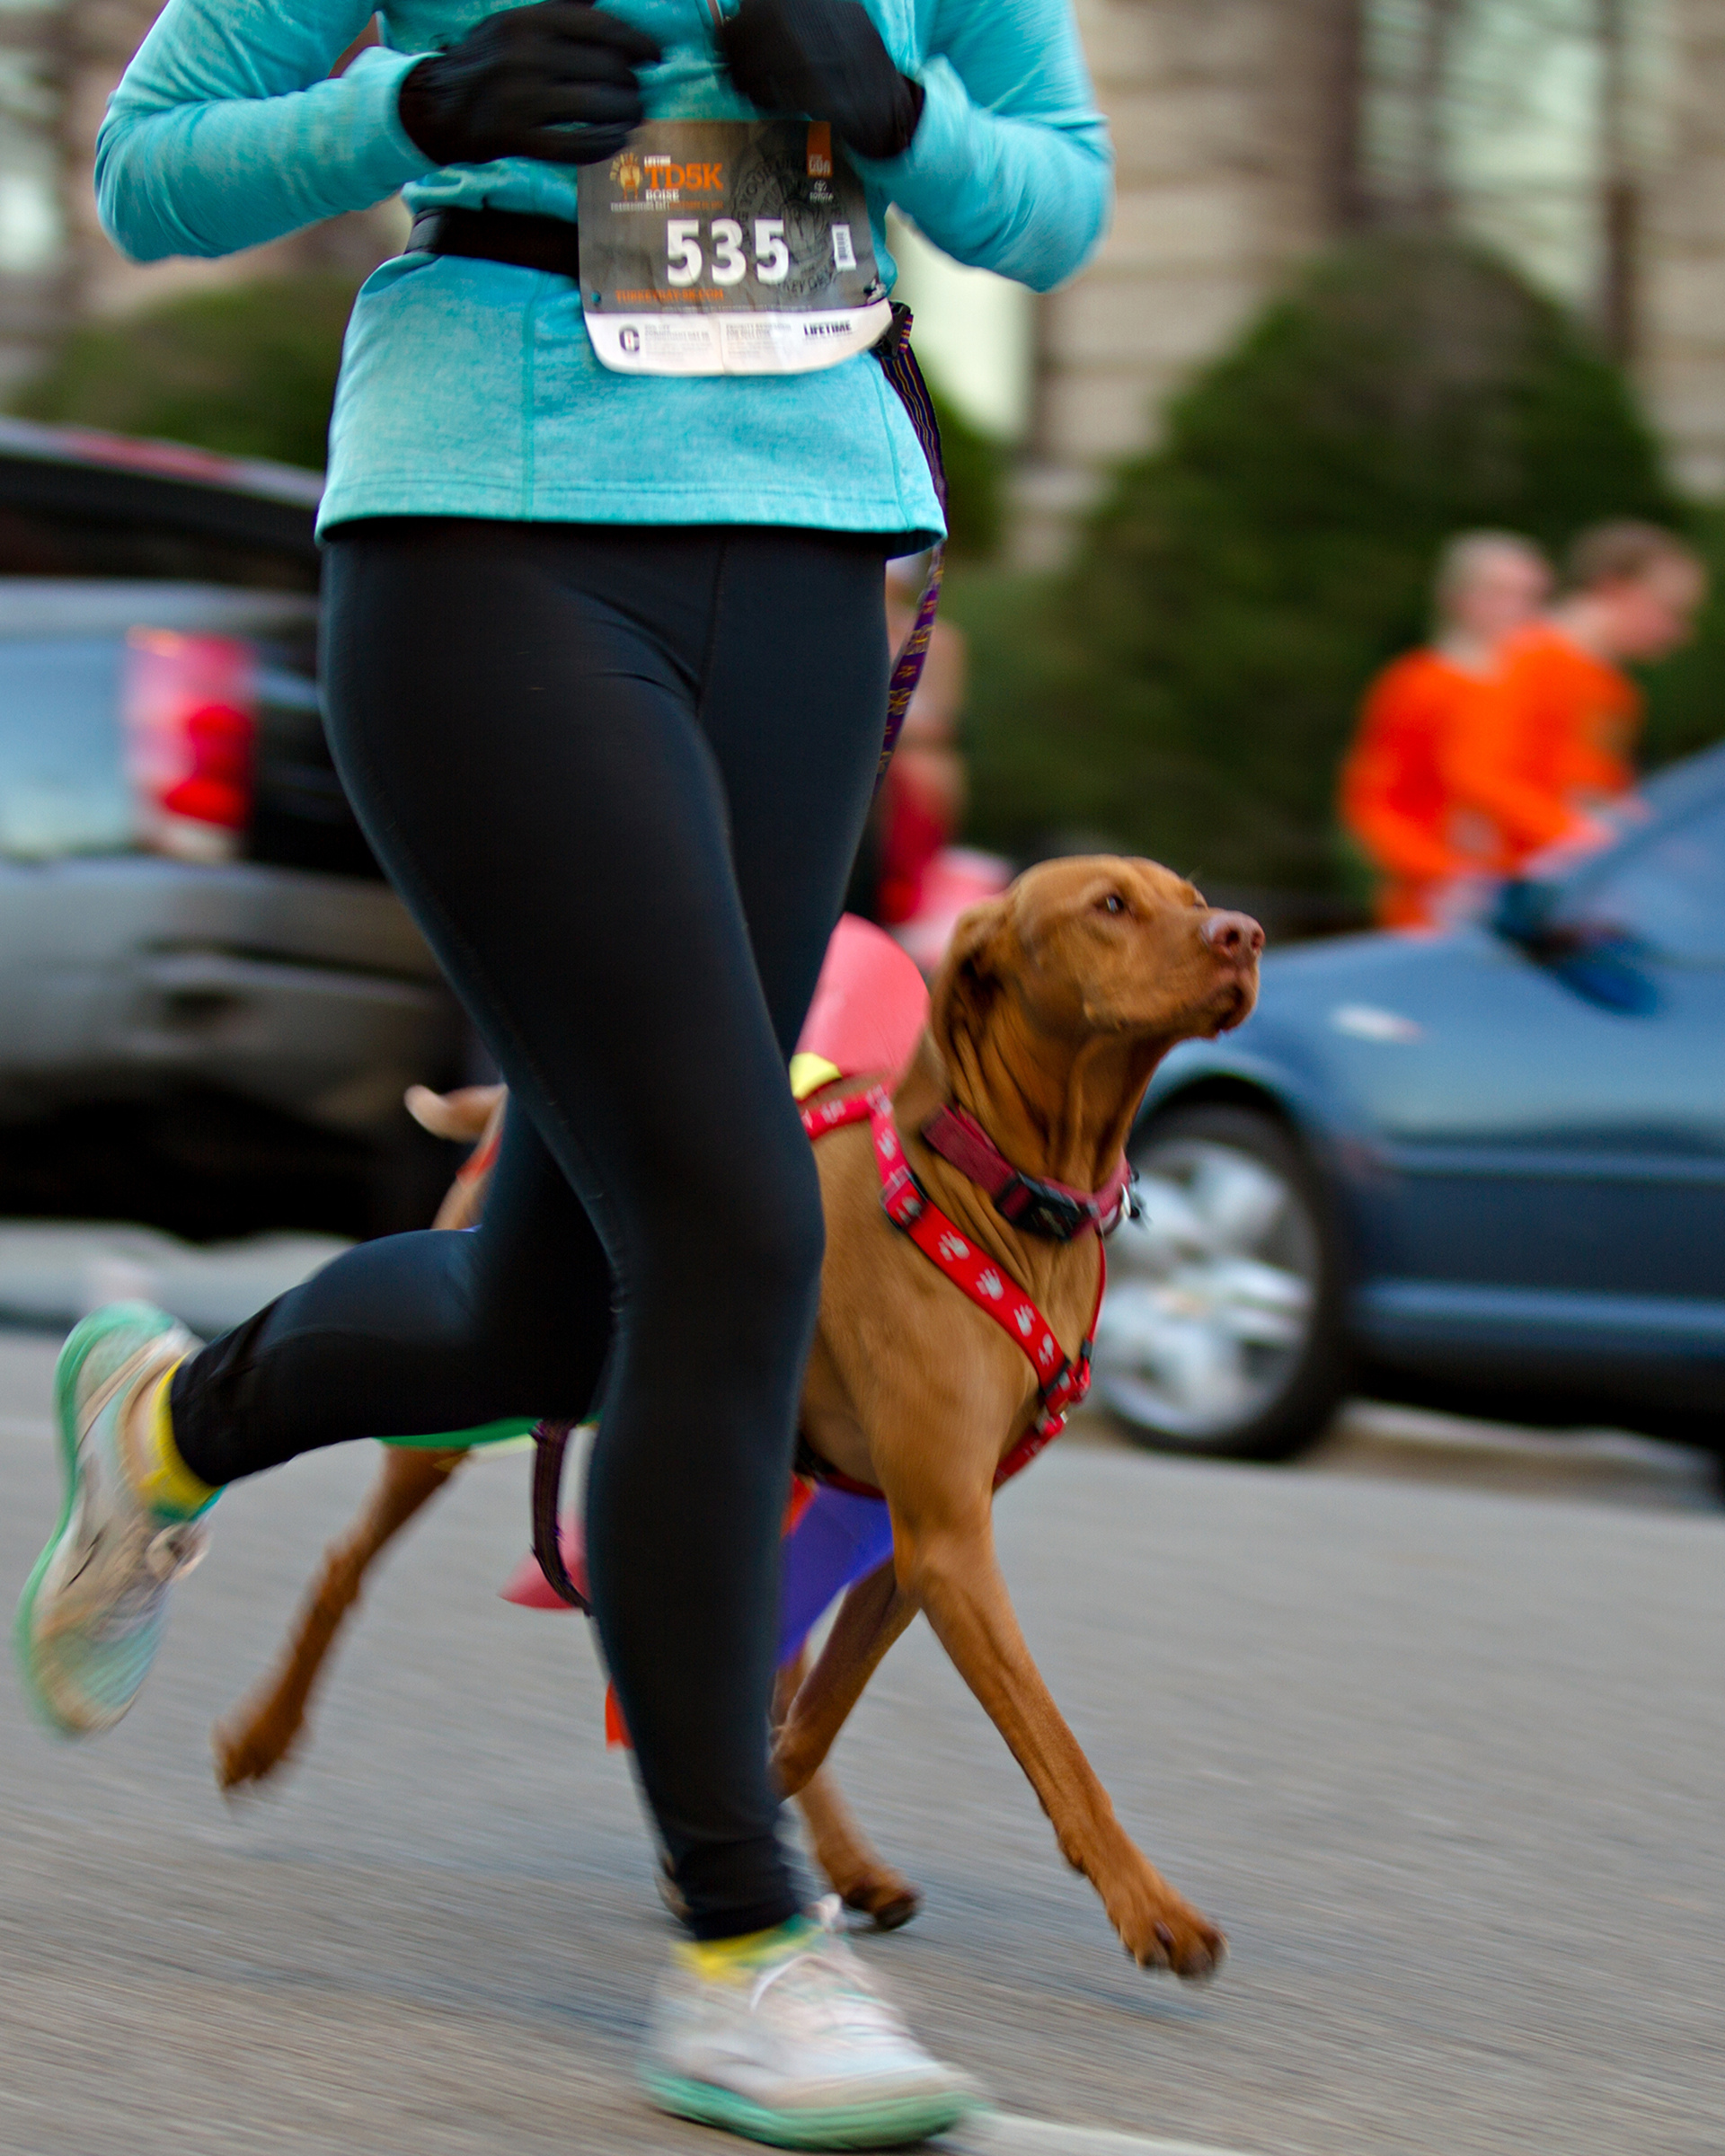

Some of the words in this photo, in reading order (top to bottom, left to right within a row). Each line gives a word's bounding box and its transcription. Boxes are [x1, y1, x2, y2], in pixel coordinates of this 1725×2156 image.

[644, 163, 723, 190] TD5K
[645, 189, 680, 202] BOISE
[668, 218, 790, 287] 535
